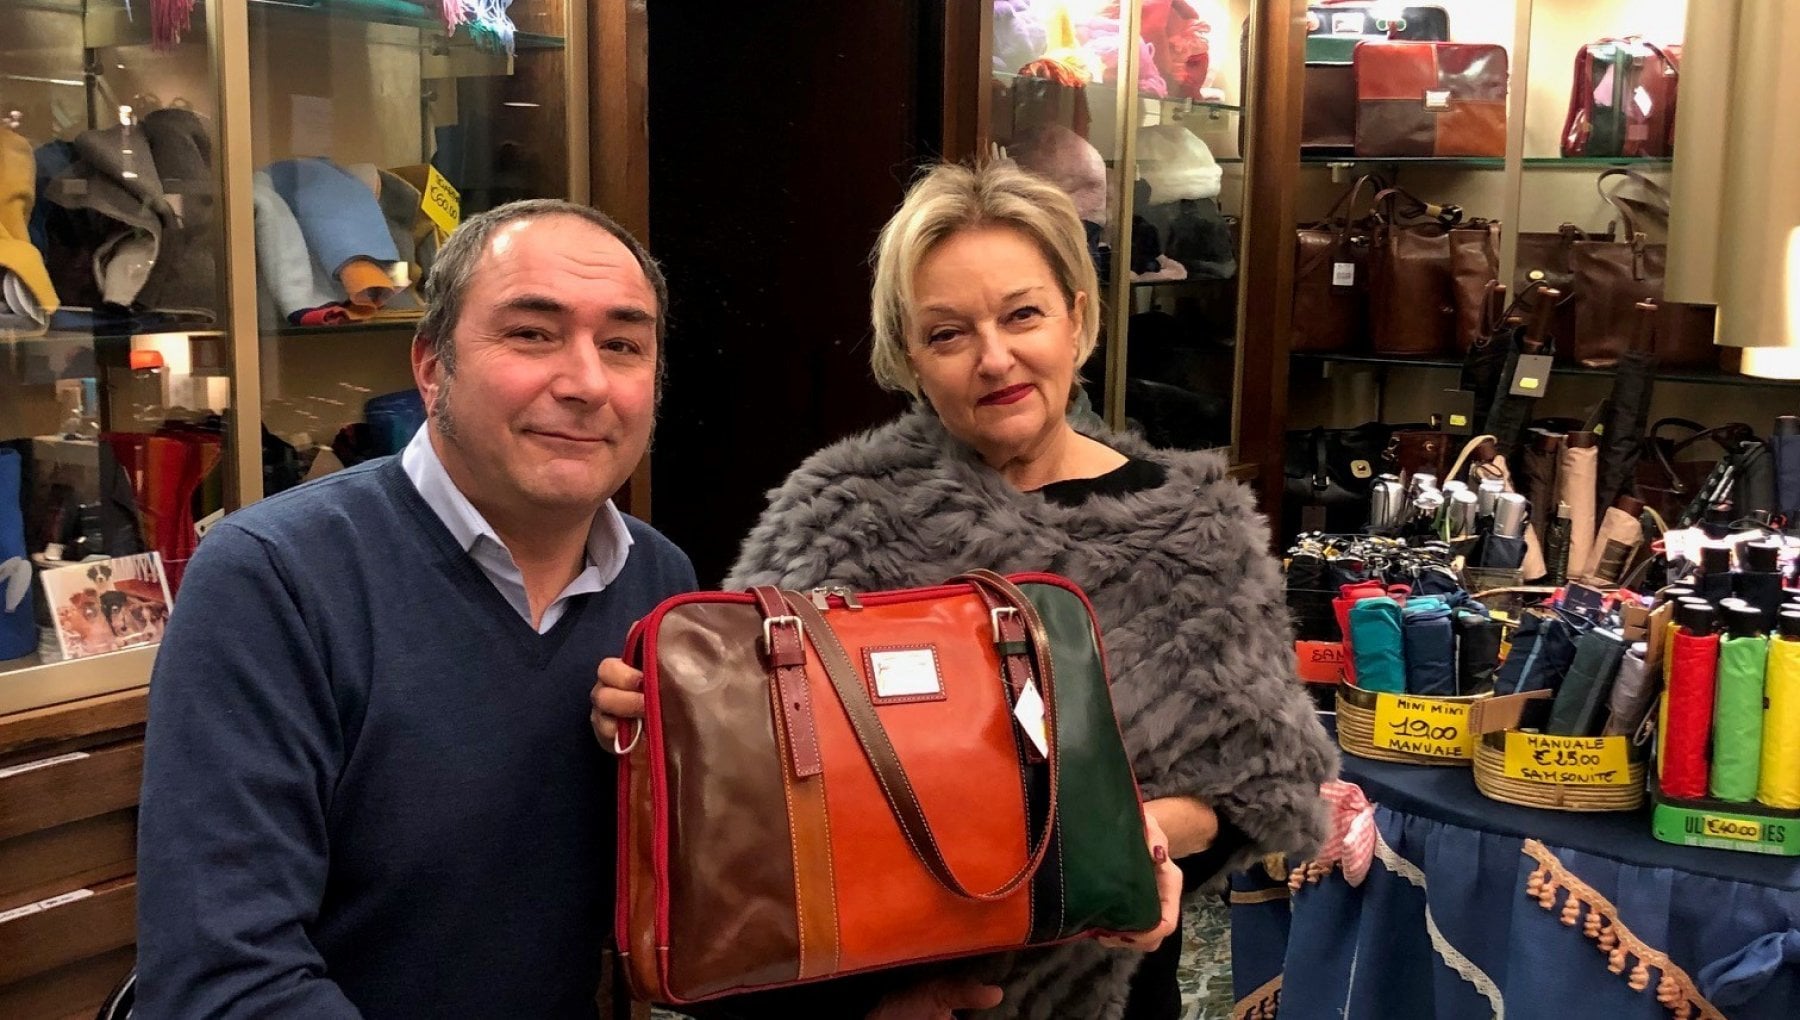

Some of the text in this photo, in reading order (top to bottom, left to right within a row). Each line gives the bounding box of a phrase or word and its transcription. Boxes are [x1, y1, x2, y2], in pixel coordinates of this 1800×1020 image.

[1397, 698, 1464, 716] MINI MINI
[1388, 738, 1463, 757] MANUALE
[1527, 736, 1605, 750] MANUALE
[1520, 767, 1618, 783] SAMSONITE
